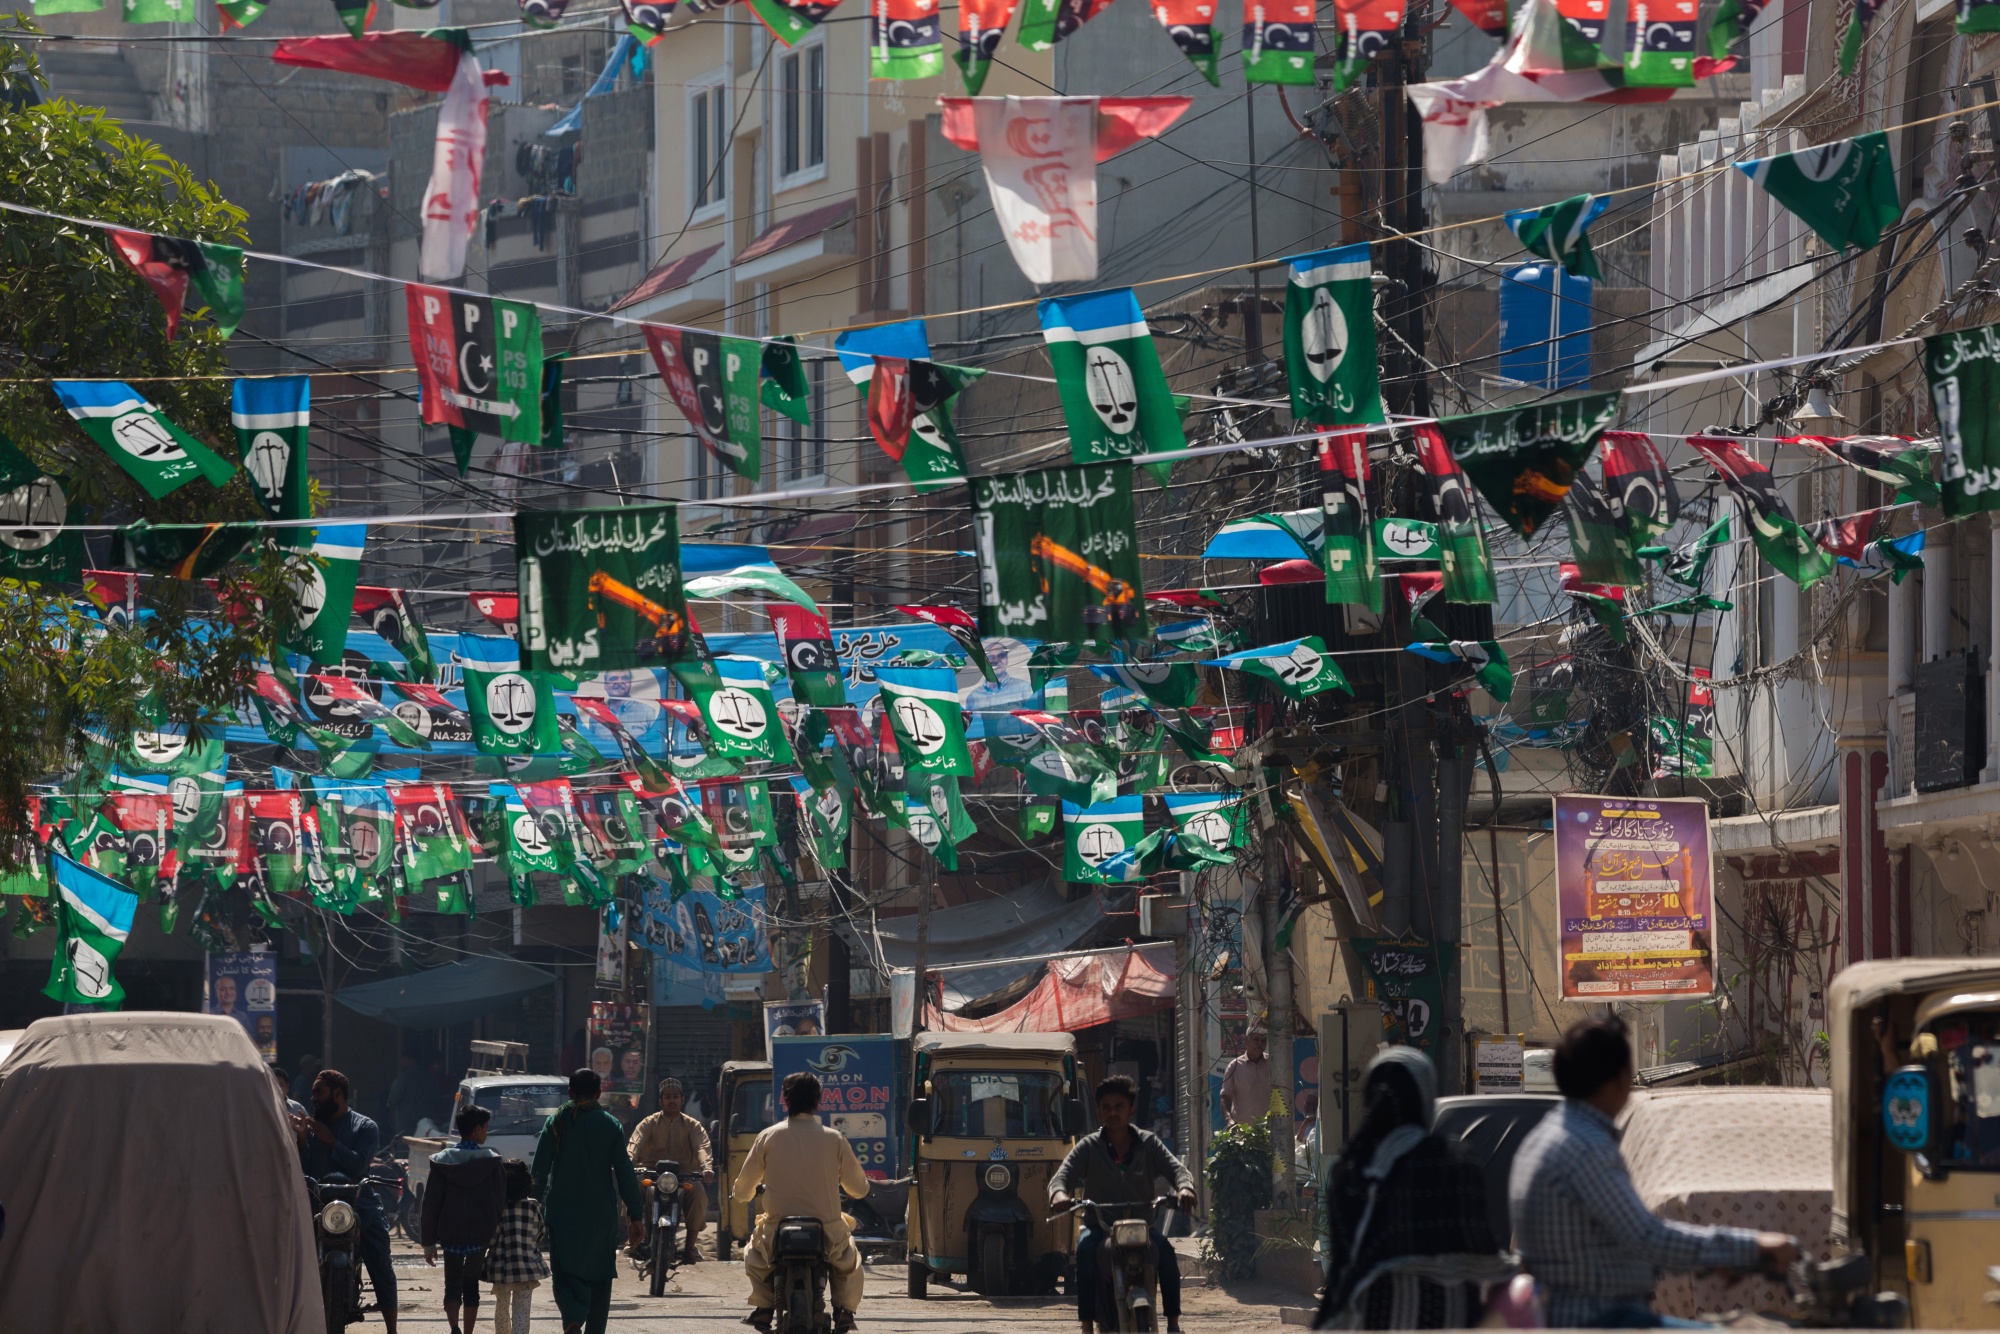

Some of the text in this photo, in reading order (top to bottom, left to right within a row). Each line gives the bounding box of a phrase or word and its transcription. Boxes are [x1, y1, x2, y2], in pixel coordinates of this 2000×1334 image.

[423, 295, 517, 338] P P P
[427, 335, 451, 356] NA
[430, 354, 452, 377] 237
[503, 351, 526, 369] PS
[661, 341, 741, 382] P P P
[505, 370, 527, 389] 103
[730, 394, 749, 413] PS
[731, 415, 749, 432] 103
[1452, 411, 1524, 460] پاکستان
[1964, 464, 2000, 496] رین
[976, 474, 1031, 510] پاکستان
[535, 513, 588, 557] پاکستان
[1080, 530, 1129, 560] انتخابی نشان
[18, 550, 67, 571] جماعت
[636, 563, 677, 592] انتخابی نشان
[998, 594, 1047, 626] کرین
[549, 627, 600, 667] کرین
[318, 721, 372, 738] کراچی کا نشا
[433, 731, 473, 742] NA-237
[920, 755, 957, 769] جماعت
[707, 786, 759, 804] P P P
[891, 766, 904, 814] P P
[1076, 866, 1101, 880] اسلامی
[1631, 853, 1679, 880] محفل
[1597, 894, 1619, 910] ہفتہ
[1635, 893, 1662, 909] فروری
[1662, 893, 1680, 908] 10
[224, 952, 265, 964] کراچی کی
[1597, 961, 1628, 971] خداداد
[1629, 960, 1657, 971] مسجد
[1657, 958, 1682, 971] جامع
[216, 966, 273, 976] جیت کا نشان
[1409, 1003, 1424, 1032] 4
[818, 1074, 863, 1082] EMON
[849, 1102, 887, 1111] OPTICS
